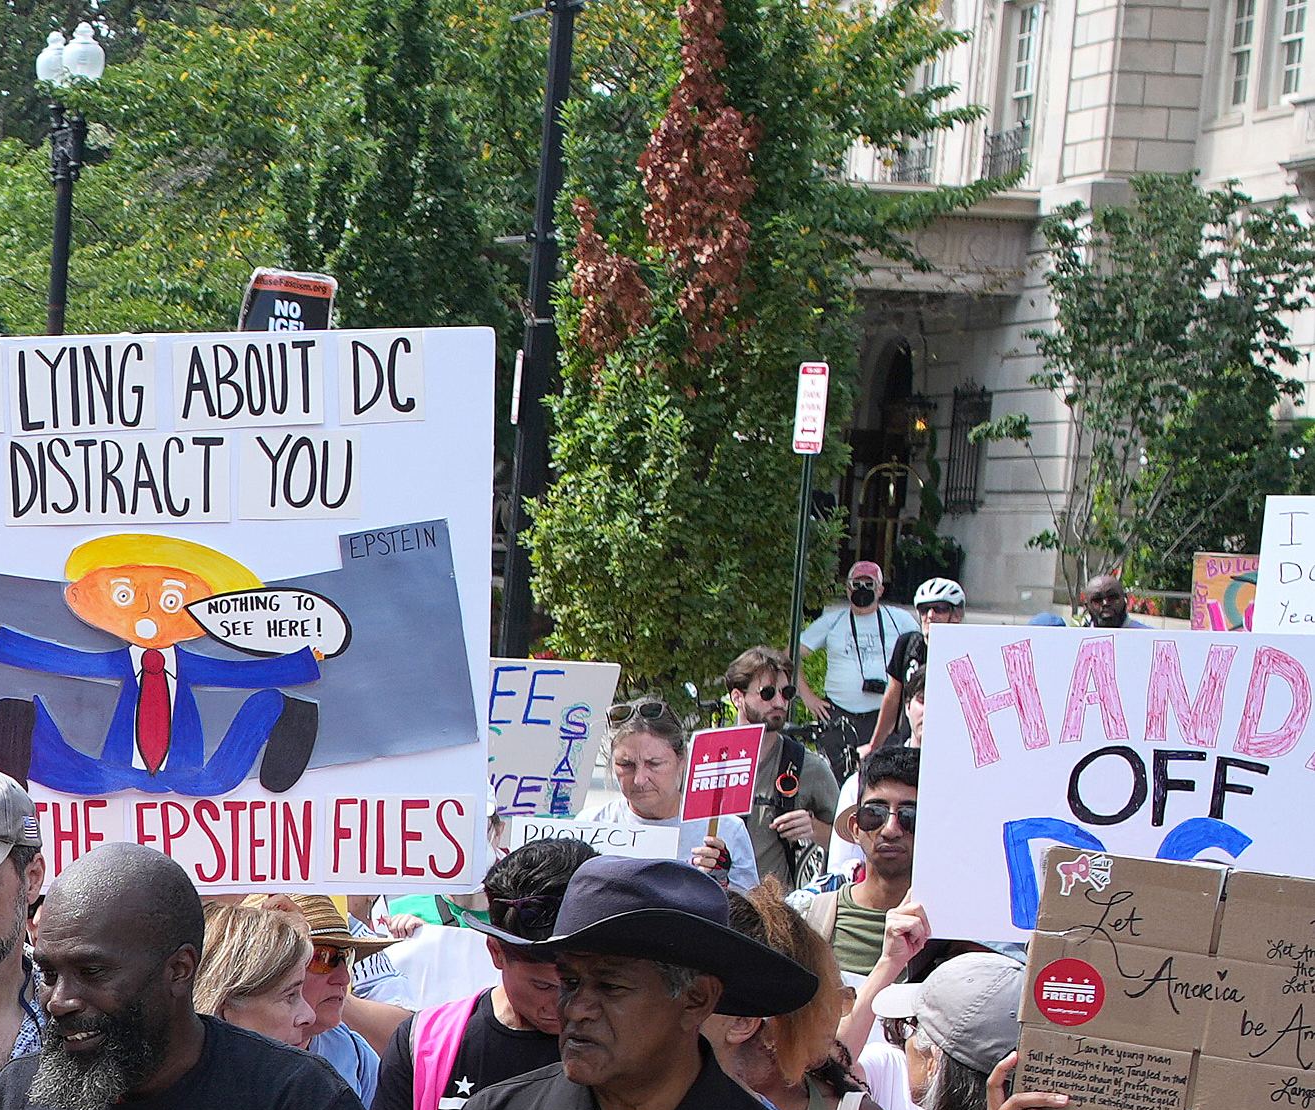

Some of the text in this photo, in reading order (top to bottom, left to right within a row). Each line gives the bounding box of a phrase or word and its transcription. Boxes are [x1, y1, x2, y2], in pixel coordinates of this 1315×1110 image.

[274, 300, 302, 319] NO
[18, 343, 144, 430] LYING
[181, 340, 315, 420] ABOUT
[352, 337, 414, 415] DC
[11, 436, 223, 518] DISTRACT
[255, 434, 352, 508] YOU
[1279, 512, 1309, 546] I
[349, 528, 436, 559] EPSTEIN
[207, 594, 316, 614] NOTHING TO
[221, 617, 323, 638] SEE HERE!
[946, 634, 1315, 772] HAND
[691, 772, 750, 792] FREE DC
[1067, 745, 1269, 827] OFF
[333, 799, 467, 878] FILES
[1077, 888, 1144, 960] Let
[1042, 991, 1095, 1004] FREE DC
[1241, 1009, 1267, 1037] be
[1027, 1049, 1043, 1061] full
[1055, 1056, 1094, 1072] strength
[1100, 1044, 1115, 1056] the
[1114, 1049, 1144, 1066] young
[1147, 1054, 1172, 1065] man
[1057, 1070, 1087, 1081] endless
